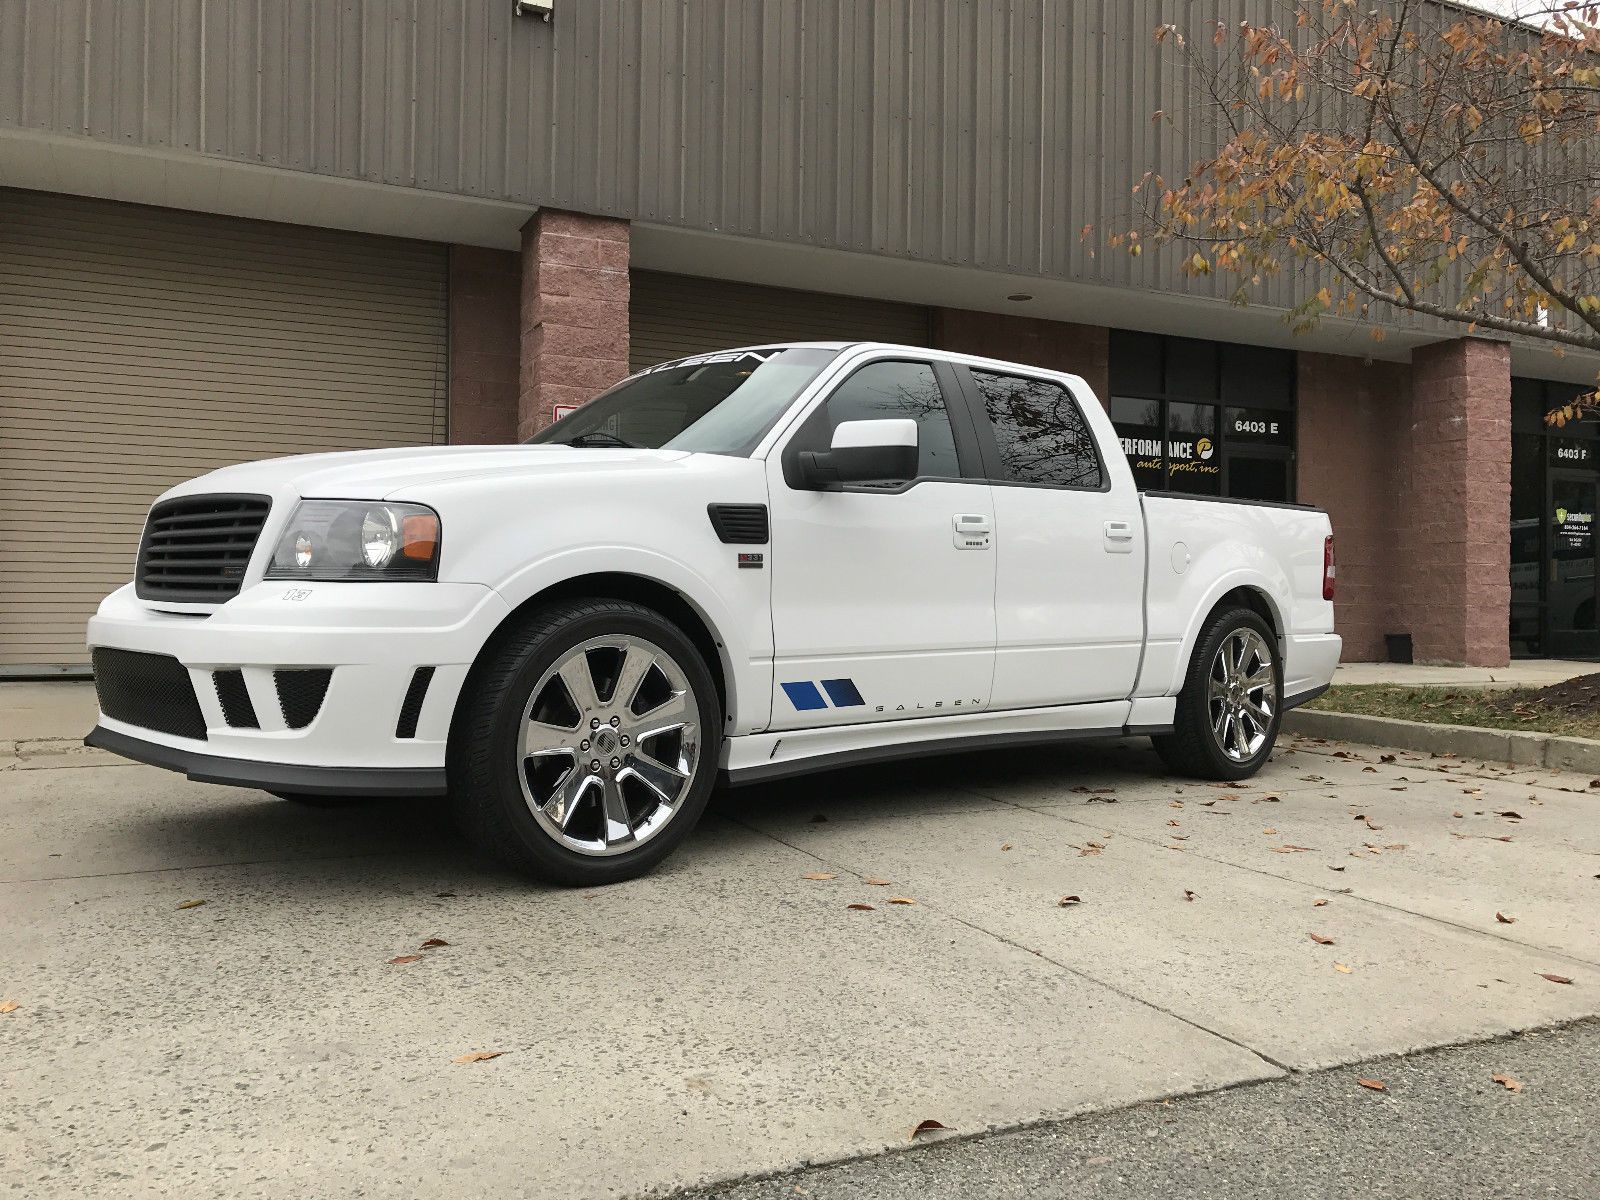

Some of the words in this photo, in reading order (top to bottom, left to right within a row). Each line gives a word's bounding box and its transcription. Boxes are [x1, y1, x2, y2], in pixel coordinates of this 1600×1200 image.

[1234, 420, 1266, 434] 6403
[1270, 423, 1279, 434] E
[1557, 447, 1579, 460] 6403
[1581, 449, 1587, 460] F
